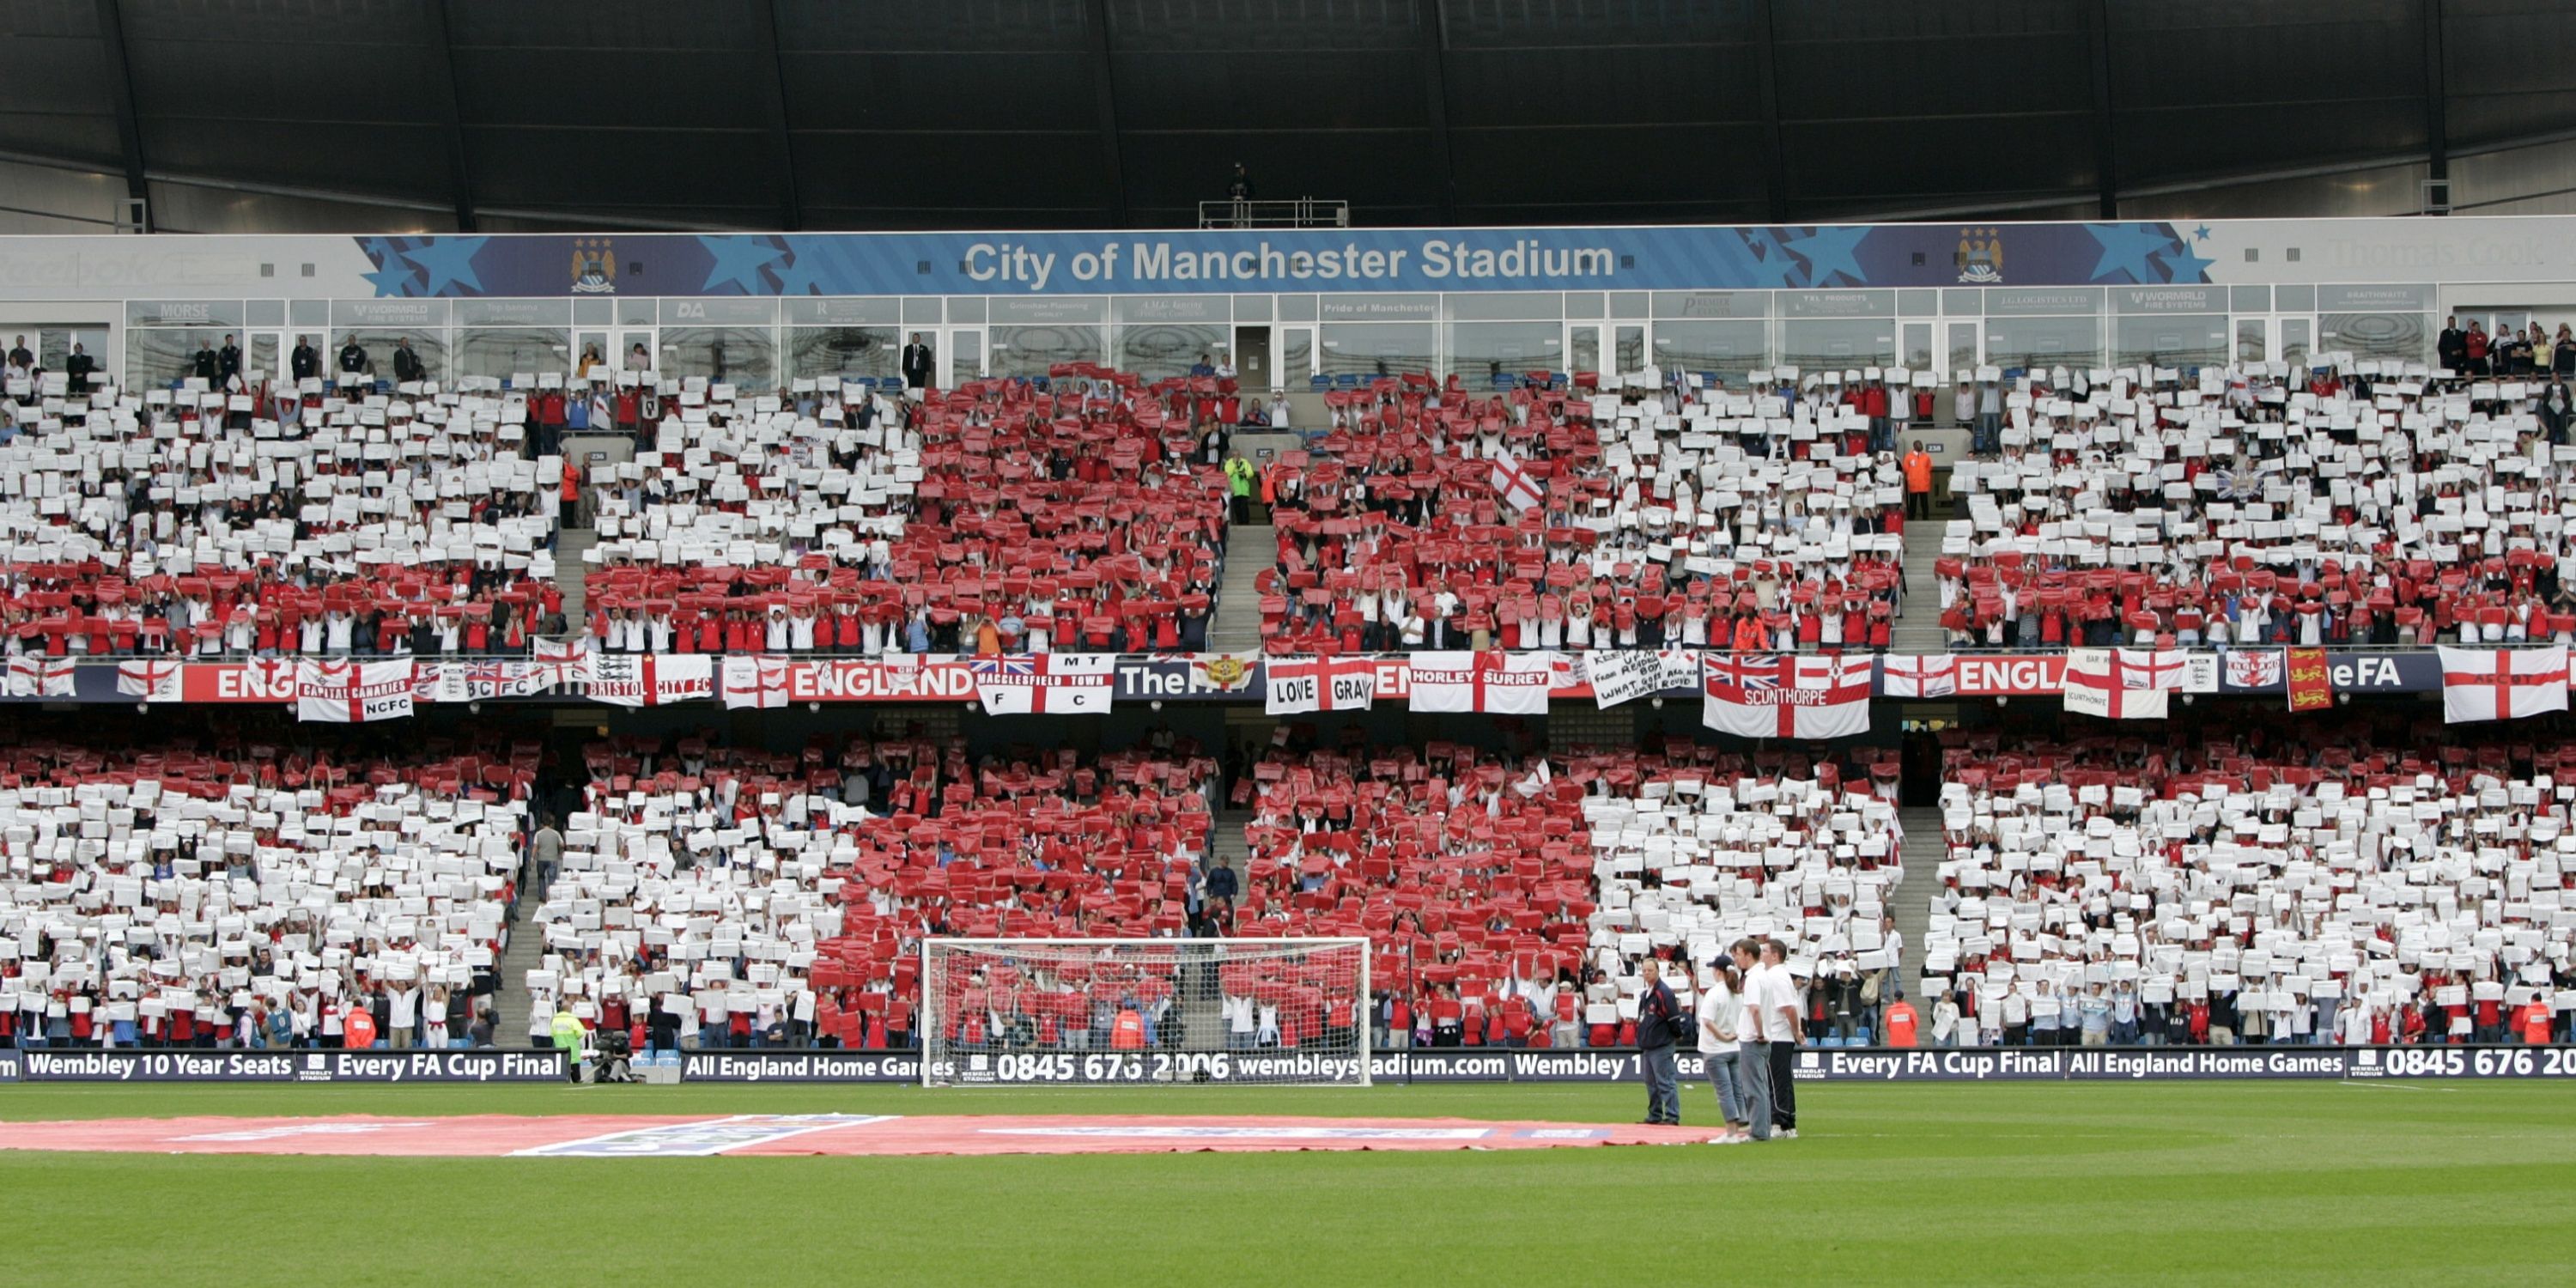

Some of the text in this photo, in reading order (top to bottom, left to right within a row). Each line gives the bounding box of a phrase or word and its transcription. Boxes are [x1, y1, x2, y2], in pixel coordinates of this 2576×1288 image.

[965, 240, 1613, 290] City of Manchester Stadium
[2145, 291, 2207, 301] WORMALD
[161, 304, 210, 318] MORSE
[368, 304, 428, 314] WORMALD
[1324, 303, 1437, 312] Pride of Manchester
[2227, 659, 2280, 671] ENGLAND
[976, 673, 1104, 686] MACCLESFIELD TOWN
[1413, 671, 1474, 683] HORLEY
[1483, 671, 1546, 685] SURREY
[1960, 661, 2064, 690] ENGL
[303, 681, 406, 700] CAPITAL CANARIES
[589, 681, 648, 696] BRISTOL
[656, 679, 686, 694] CITY
[694, 678, 711, 692] FC
[1276, 679, 1314, 703] LOVE
[1601, 681, 1636, 700] WHAT
[366, 698, 409, 714] NCFC
[1745, 688, 1826, 706] SCUNTHORPE
[27, 1054, 292, 1079] Wembley 10 Year Seats
[338, 1053, 562, 1080] Every FA Cup Final
[686, 1056, 714, 1076] All
[720, 1056, 808, 1080] England
[814, 1057, 878, 1077] Home
[997, 1054, 1074, 1080] 0845
[1084, 1054, 1142, 1080] 676
[1238, 1054, 1504, 1080] wembleysadium.com
[1515, 1054, 1625, 1080] Wembley
[1832, 1052, 2060, 1079] Every FA Cup Final
[2070, 1053, 2342, 1078] All England Home Games
[2385, 1049, 2464, 1075] 0845
[2475, 1048, 2533, 1075] 676
